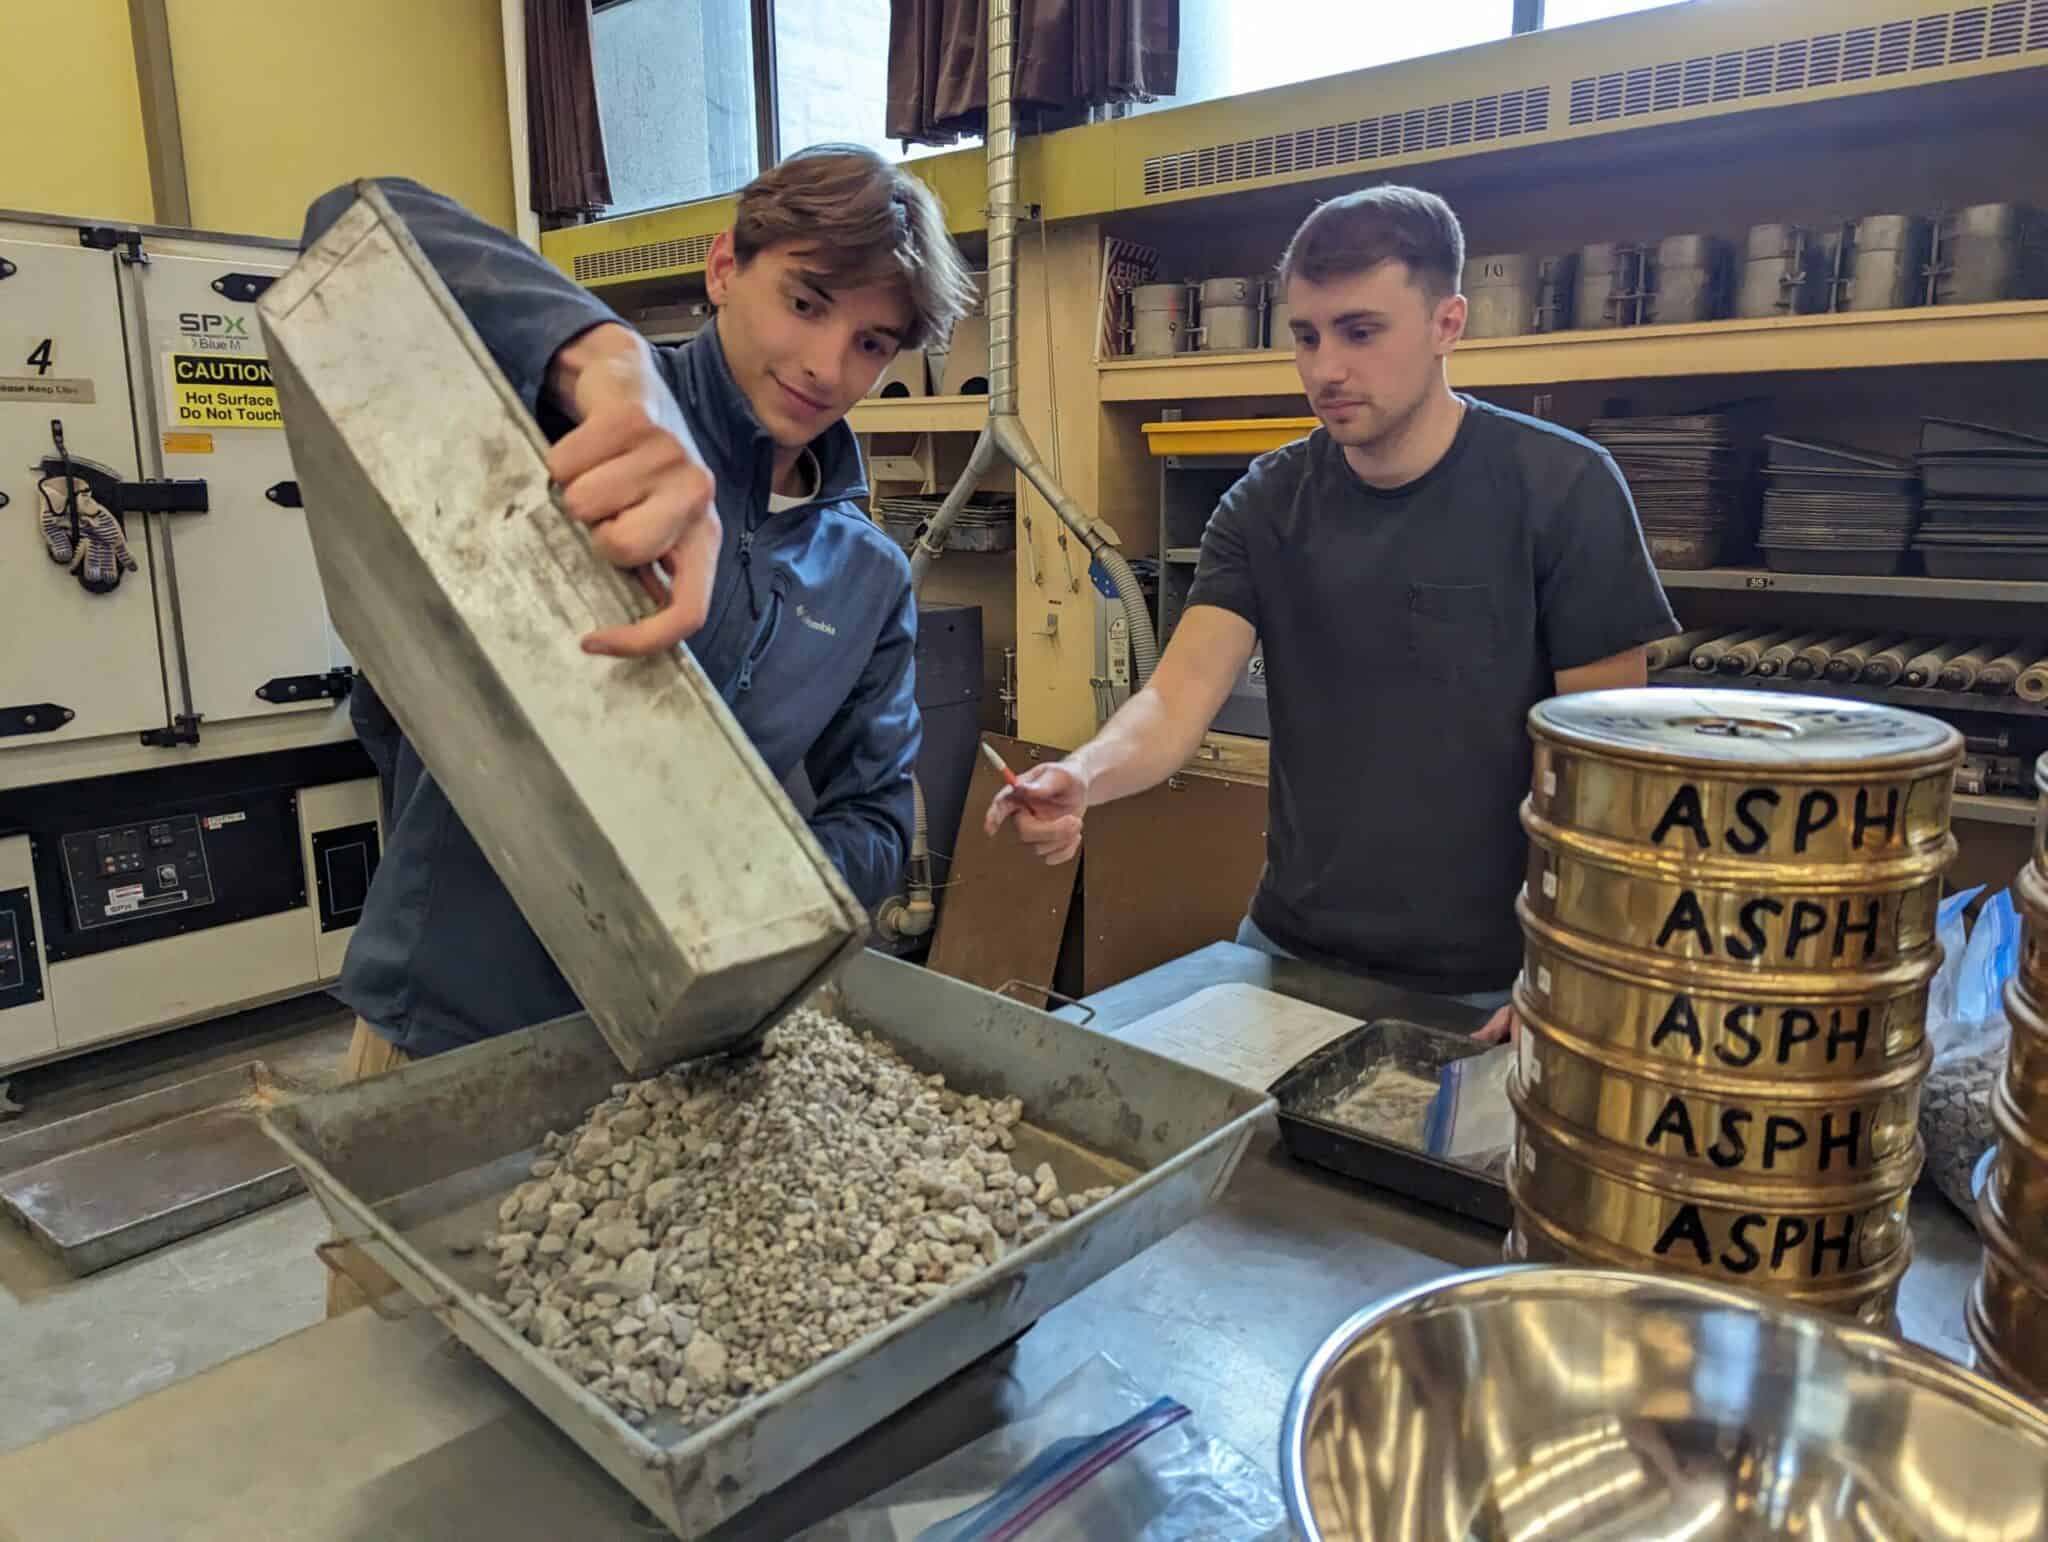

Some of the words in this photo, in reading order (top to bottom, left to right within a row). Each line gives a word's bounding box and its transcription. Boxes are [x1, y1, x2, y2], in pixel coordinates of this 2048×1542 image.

[1484, 263, 1504, 278] 10
[1234, 281, 1246, 300] 3
[179, 313, 247, 335] SPX
[199, 337, 227, 351] Blue
[27, 339, 52, 375] 4
[177, 361, 273, 382] CAUTION
[185, 391, 212, 405] Hot
[217, 393, 273, 406] Surface
[180, 407, 201, 420] Do
[206, 408, 232, 420] Not
[236, 409, 281, 421] Touch
[1650, 783, 1899, 855] ASPH
[1655, 889, 1881, 963] ASPH
[1651, 992, 1870, 1068] ASPH
[1646, 1095, 1863, 1171] ASPH
[1653, 1202, 1855, 1276] ASPH
